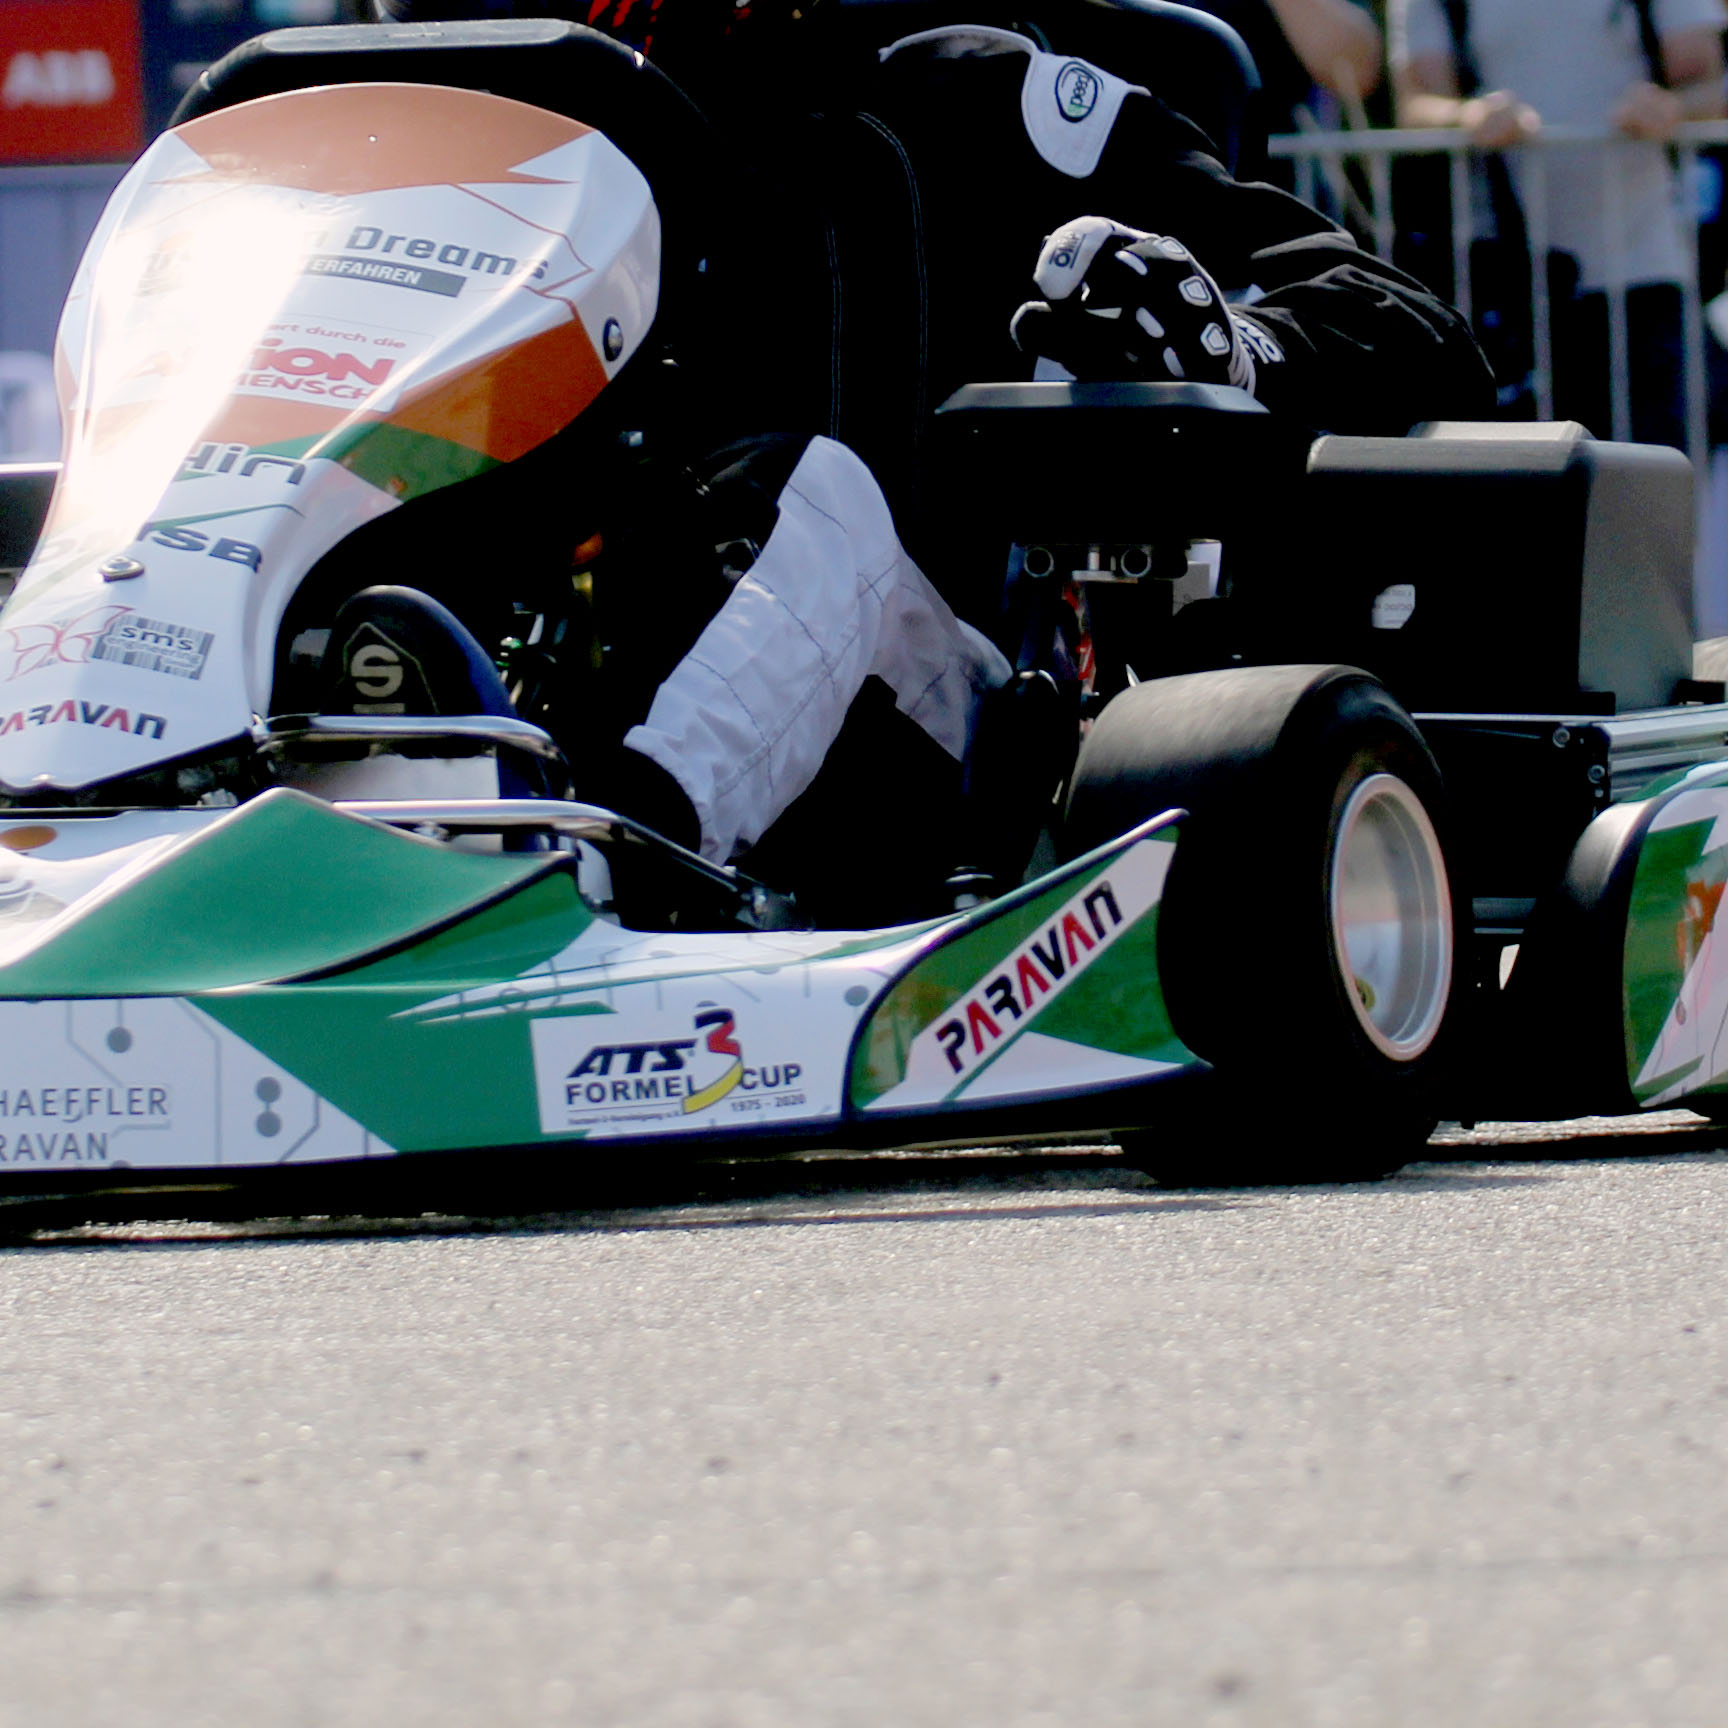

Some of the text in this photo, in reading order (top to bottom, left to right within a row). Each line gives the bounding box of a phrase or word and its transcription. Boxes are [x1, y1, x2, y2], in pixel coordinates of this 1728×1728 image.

[1, 49, 117, 110] ABB
[310, 254, 422, 286] ERFAHREN
[345, 225, 549, 282] Dreams
[305, 325, 368, 344] durch
[373, 337, 407, 351] die
[248, 338, 397, 386] iON
[120, 625, 194, 651] sms
[934, 878, 1124, 1074] PARAVAN
[565, 1038, 699, 1078] ATS
[565, 1063, 802, 1105] FORMEL CUP
